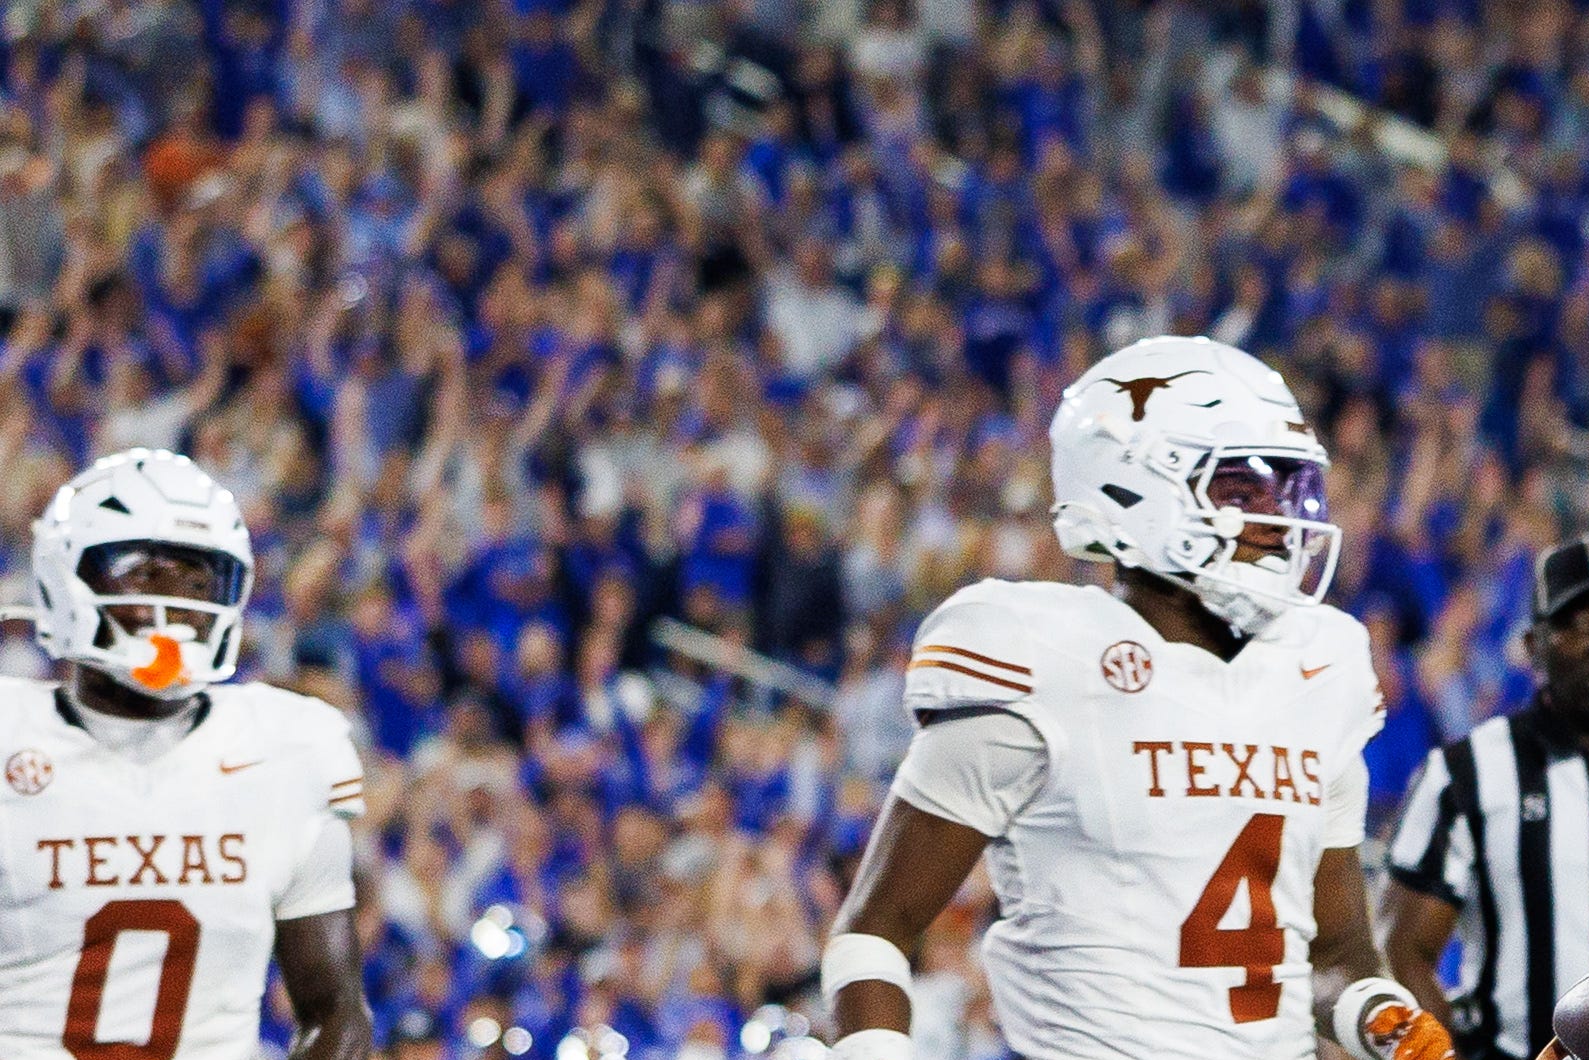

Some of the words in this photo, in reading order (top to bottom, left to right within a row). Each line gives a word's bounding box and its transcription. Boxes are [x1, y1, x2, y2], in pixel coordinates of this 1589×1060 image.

[1133, 742, 1321, 806] TEXAS
[37, 834, 247, 888] TEXAS
[1178, 813, 1286, 1024] 4
